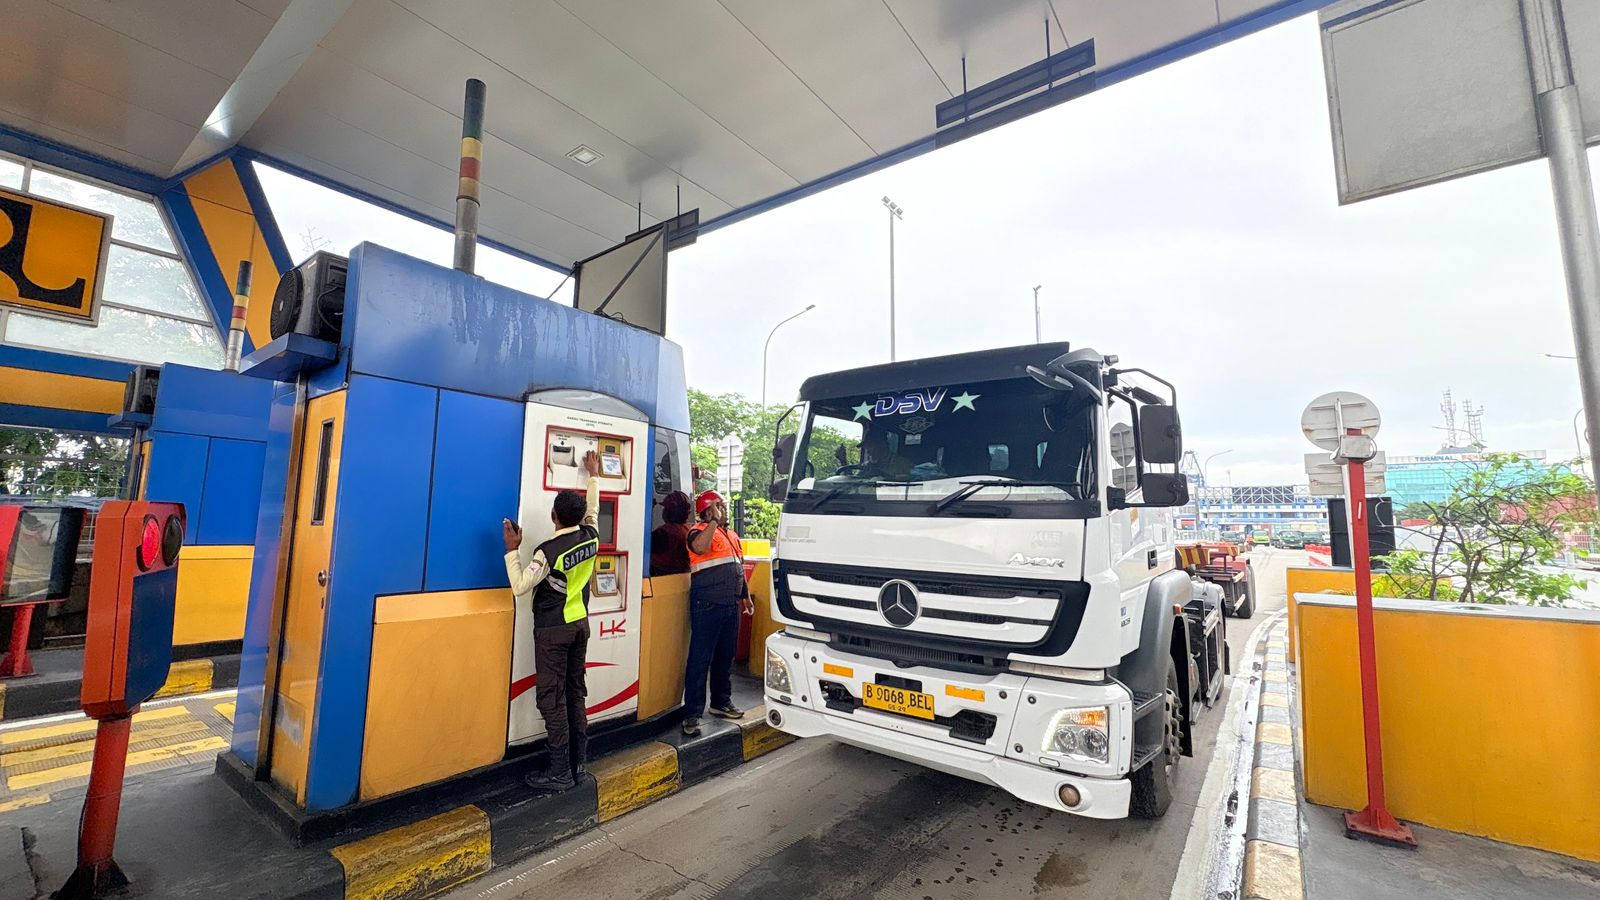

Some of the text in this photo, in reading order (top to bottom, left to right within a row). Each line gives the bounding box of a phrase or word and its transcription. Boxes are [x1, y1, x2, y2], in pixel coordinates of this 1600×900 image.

[875, 388, 948, 417] DSV
[564, 543, 596, 569] SATPAM
[600, 619, 626, 636] HK
[866, 685, 931, 710] B 9068 BEL
